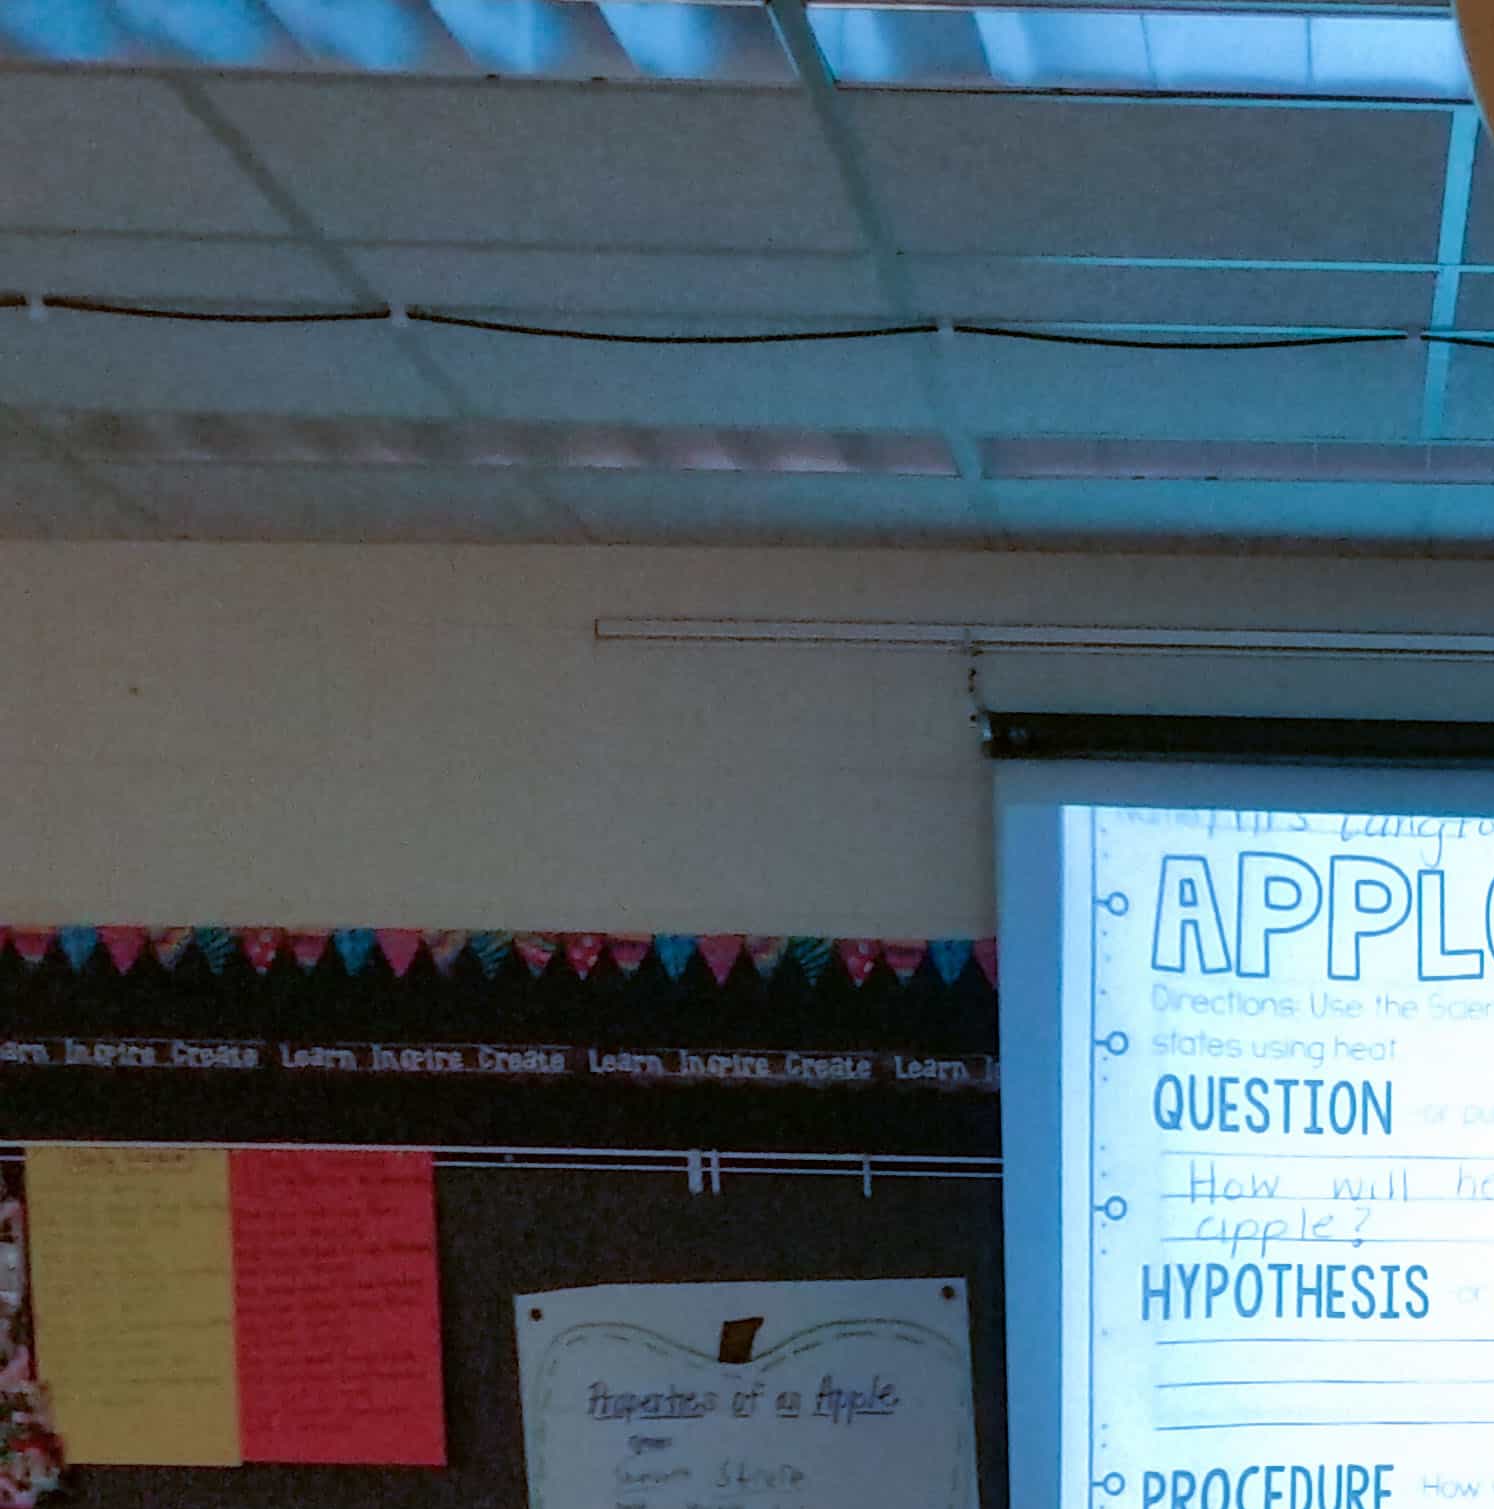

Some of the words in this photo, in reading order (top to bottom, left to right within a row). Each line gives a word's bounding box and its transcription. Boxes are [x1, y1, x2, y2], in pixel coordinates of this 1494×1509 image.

[1309, 991, 1364, 1020] Use
[1375, 992, 1418, 1020] the
[170, 1040, 260, 1068] Create
[280, 1042, 359, 1070] Learn
[477, 1044, 567, 1073] Create
[587, 1047, 664, 1075] Learn
[783, 1050, 873, 1079] Create
[894, 1054, 970, 1081] Learn
[1151, 1030, 1242, 1058] states
[1251, 1035, 1325, 1068] using
[1151, 1073, 1393, 1137] QUESTION
[1188, 1160, 1280, 1205] How
[1330, 1168, 1410, 1204] will
[1140, 1262, 1431, 1321] HYPOTHESIS
[1421, 1473, 1481, 1499] How
